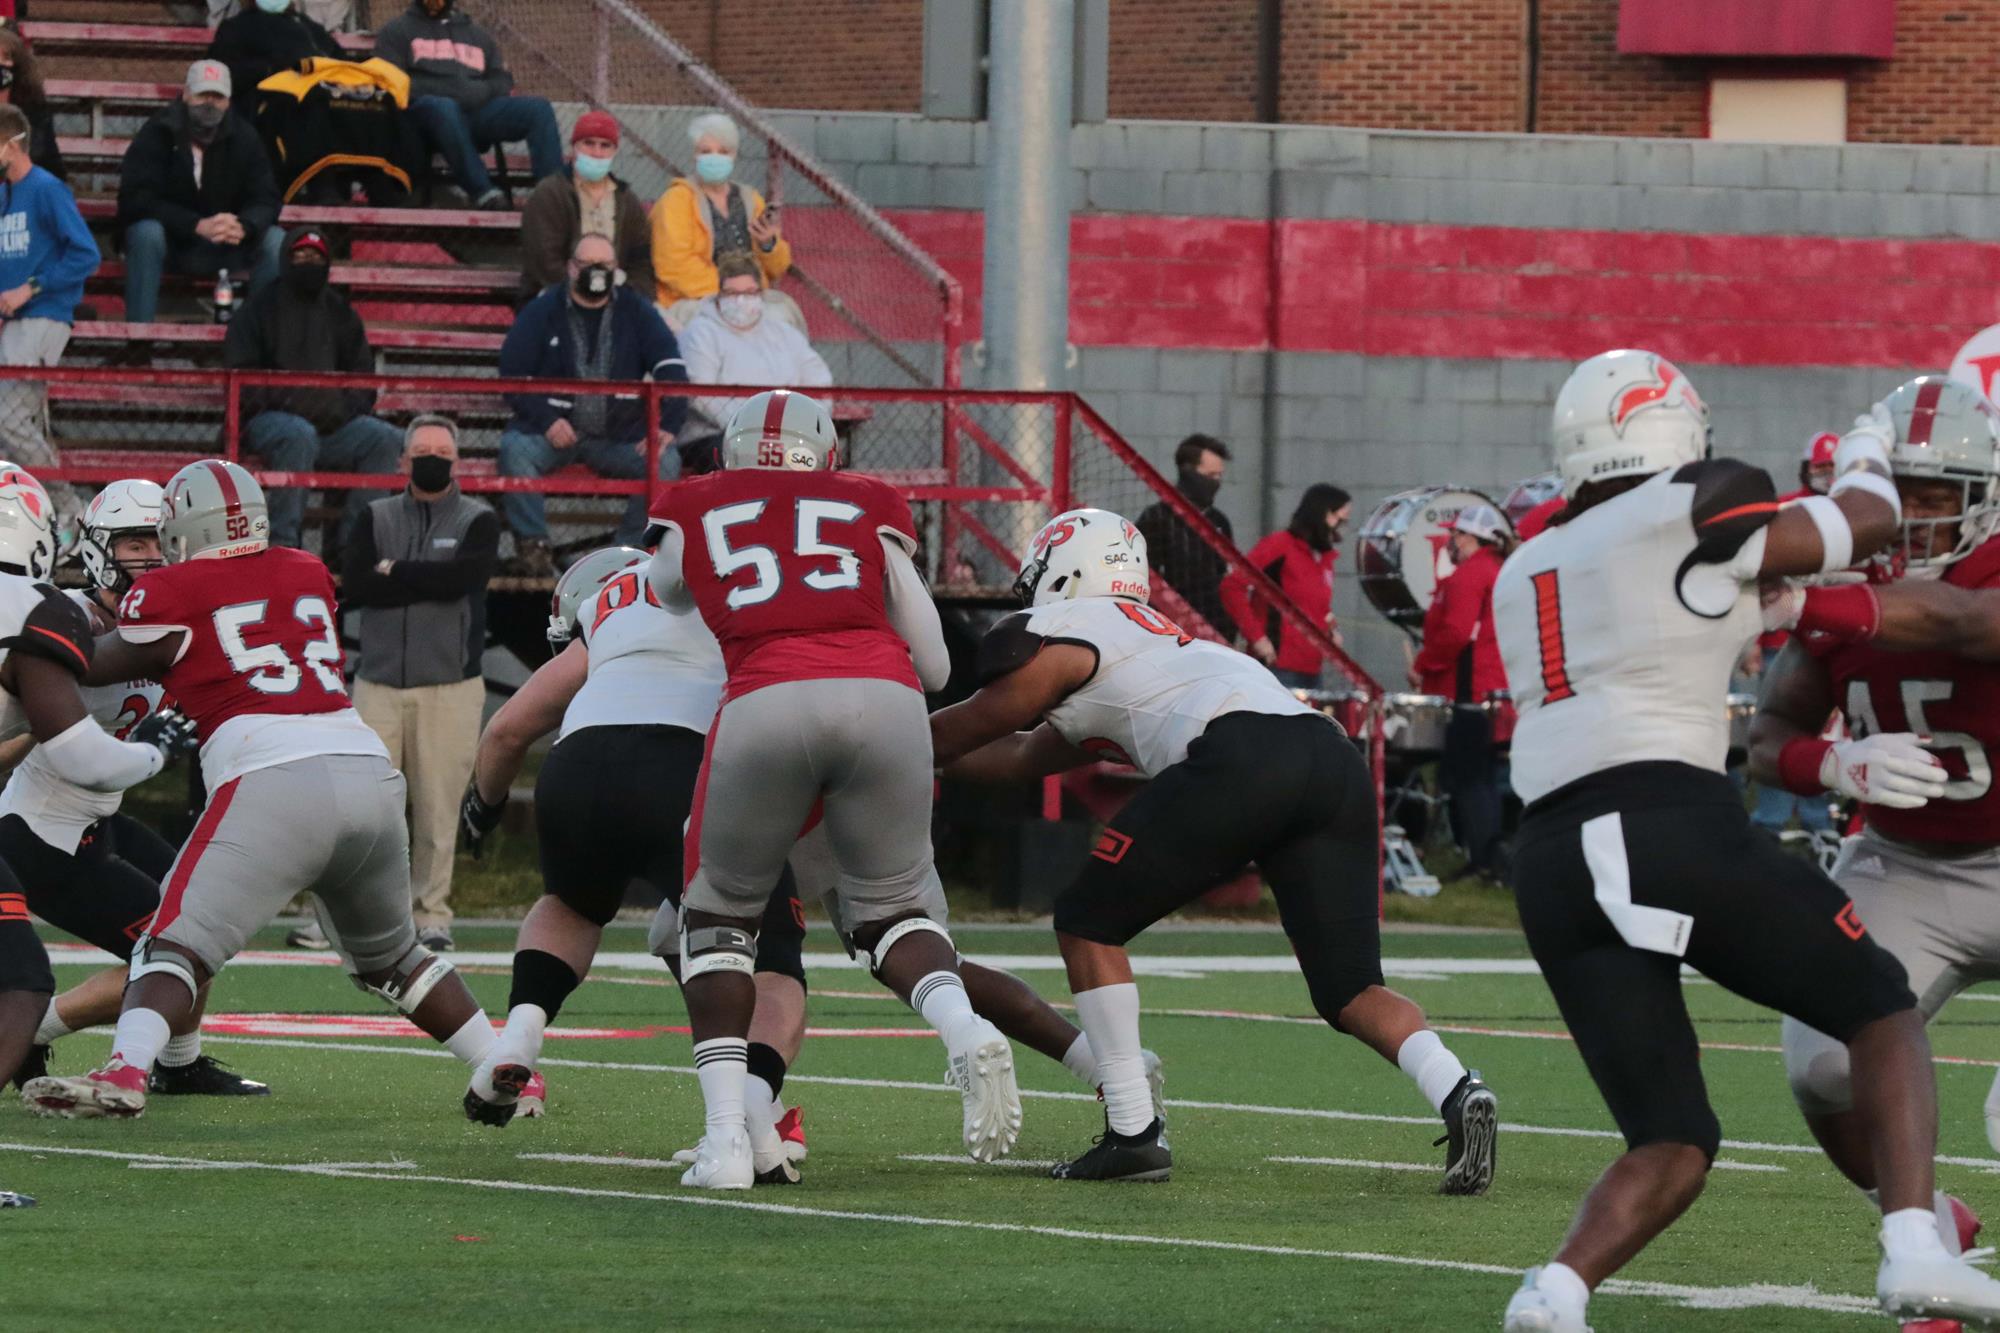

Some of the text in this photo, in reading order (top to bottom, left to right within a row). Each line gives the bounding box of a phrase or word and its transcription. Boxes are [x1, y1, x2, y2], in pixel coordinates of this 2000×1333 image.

[758, 441, 784, 467] 55
[791, 452, 814, 468] SAC
[226, 515, 249, 541] 52
[702, 496, 866, 611] 55
[1104, 552, 1129, 566] SAC
[211, 595, 349, 695] 52
[1531, 568, 1577, 706] 1
